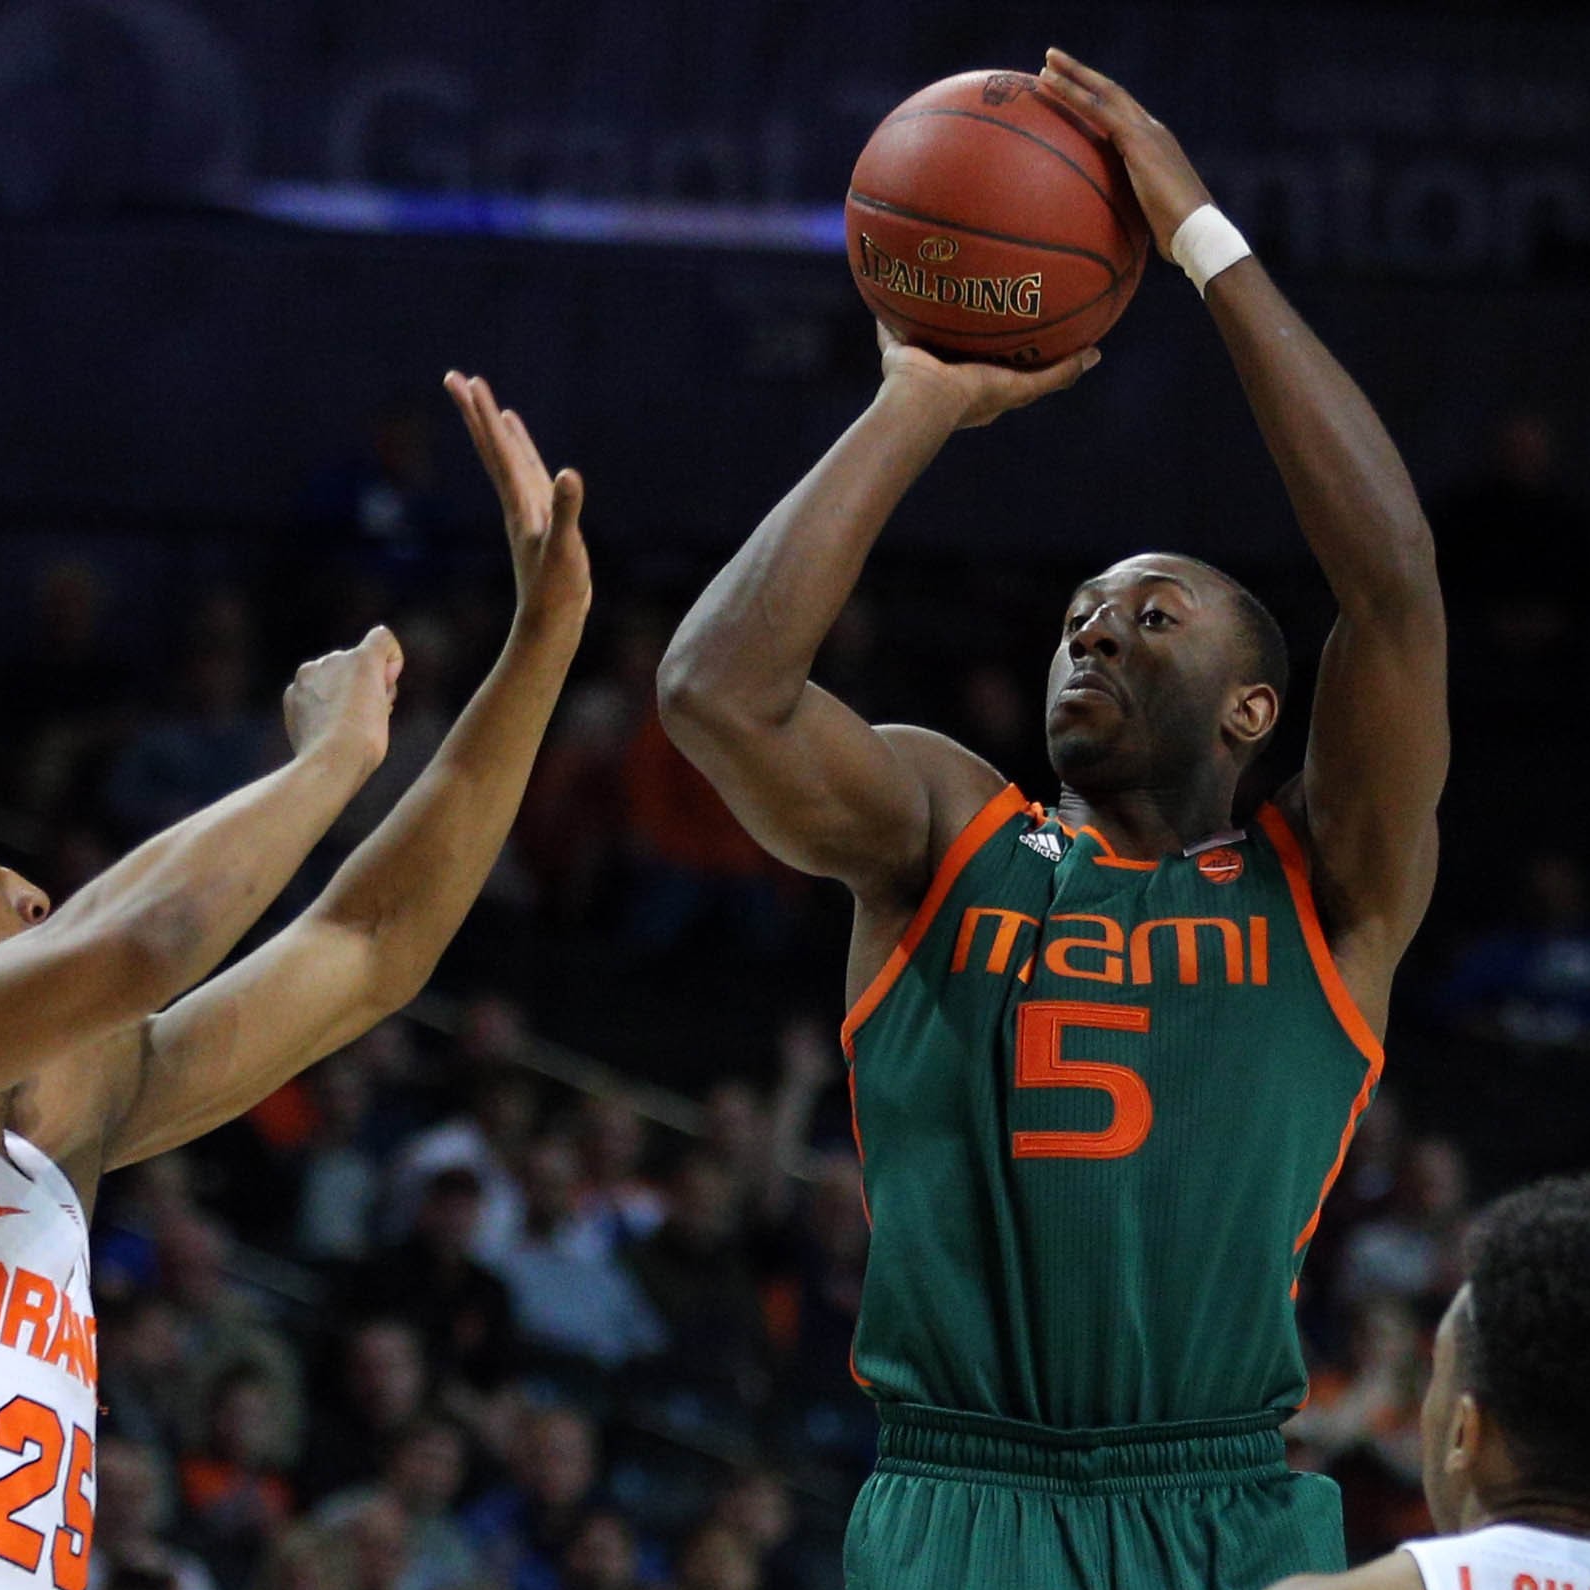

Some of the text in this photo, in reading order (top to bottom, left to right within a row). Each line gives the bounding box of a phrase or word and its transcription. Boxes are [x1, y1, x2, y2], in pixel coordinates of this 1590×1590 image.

[859, 232, 1043, 319] SPALDING
[1018, 834, 1061, 862] adida
[1012, 1001, 1153, 1159] 5
